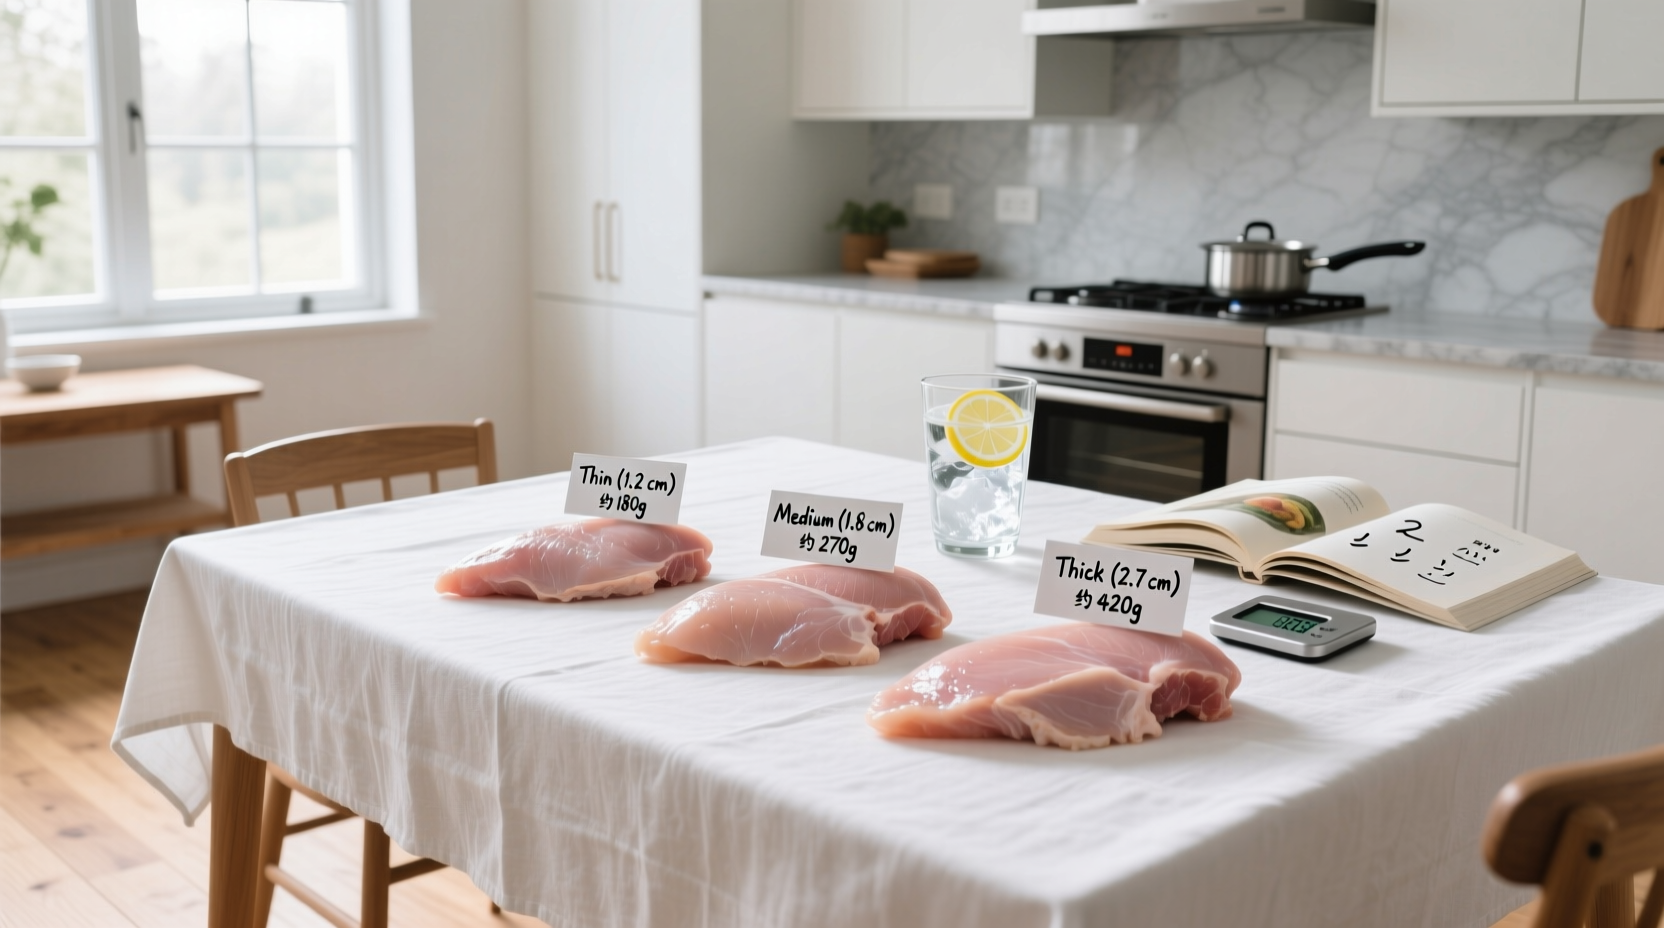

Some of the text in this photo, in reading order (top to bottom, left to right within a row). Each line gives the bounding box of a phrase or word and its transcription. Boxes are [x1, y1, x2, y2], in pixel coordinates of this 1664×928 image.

[580, 465, 612, 486] Thin
[617, 494, 647, 519] 180g
[773, 503, 834, 527] Medium
[818, 536, 857, 563] 270g
[1056, 556, 1104, 583] Thick
[1097, 593, 1142, 625] 420g
